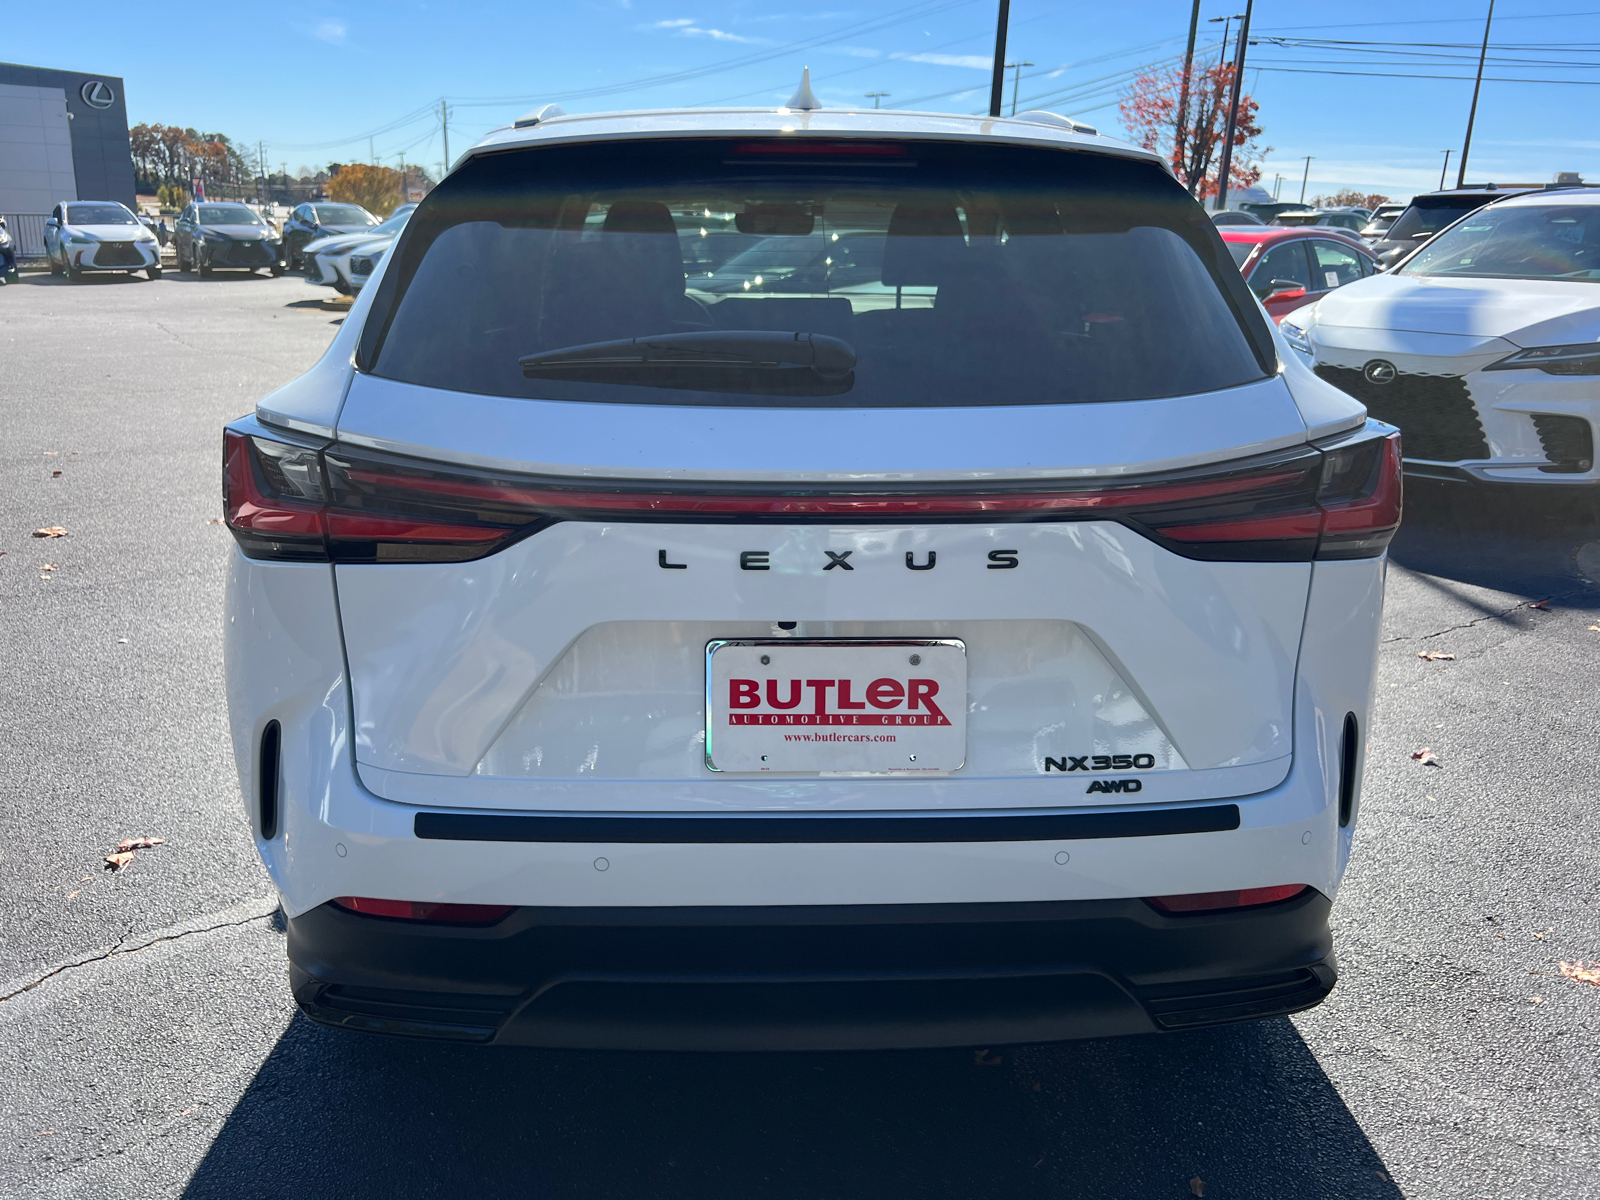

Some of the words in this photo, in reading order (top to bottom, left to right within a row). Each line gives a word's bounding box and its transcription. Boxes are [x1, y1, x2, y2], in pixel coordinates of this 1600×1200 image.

[658, 549, 1019, 571] LEXUS
[730, 715, 859, 725] AUTOMOTIVE
[881, 715, 945, 725] GROUP
[783, 732, 897, 743] www.butlercars.com
[1044, 753, 1156, 772] NX350
[1086, 779, 1142, 794] AWD
